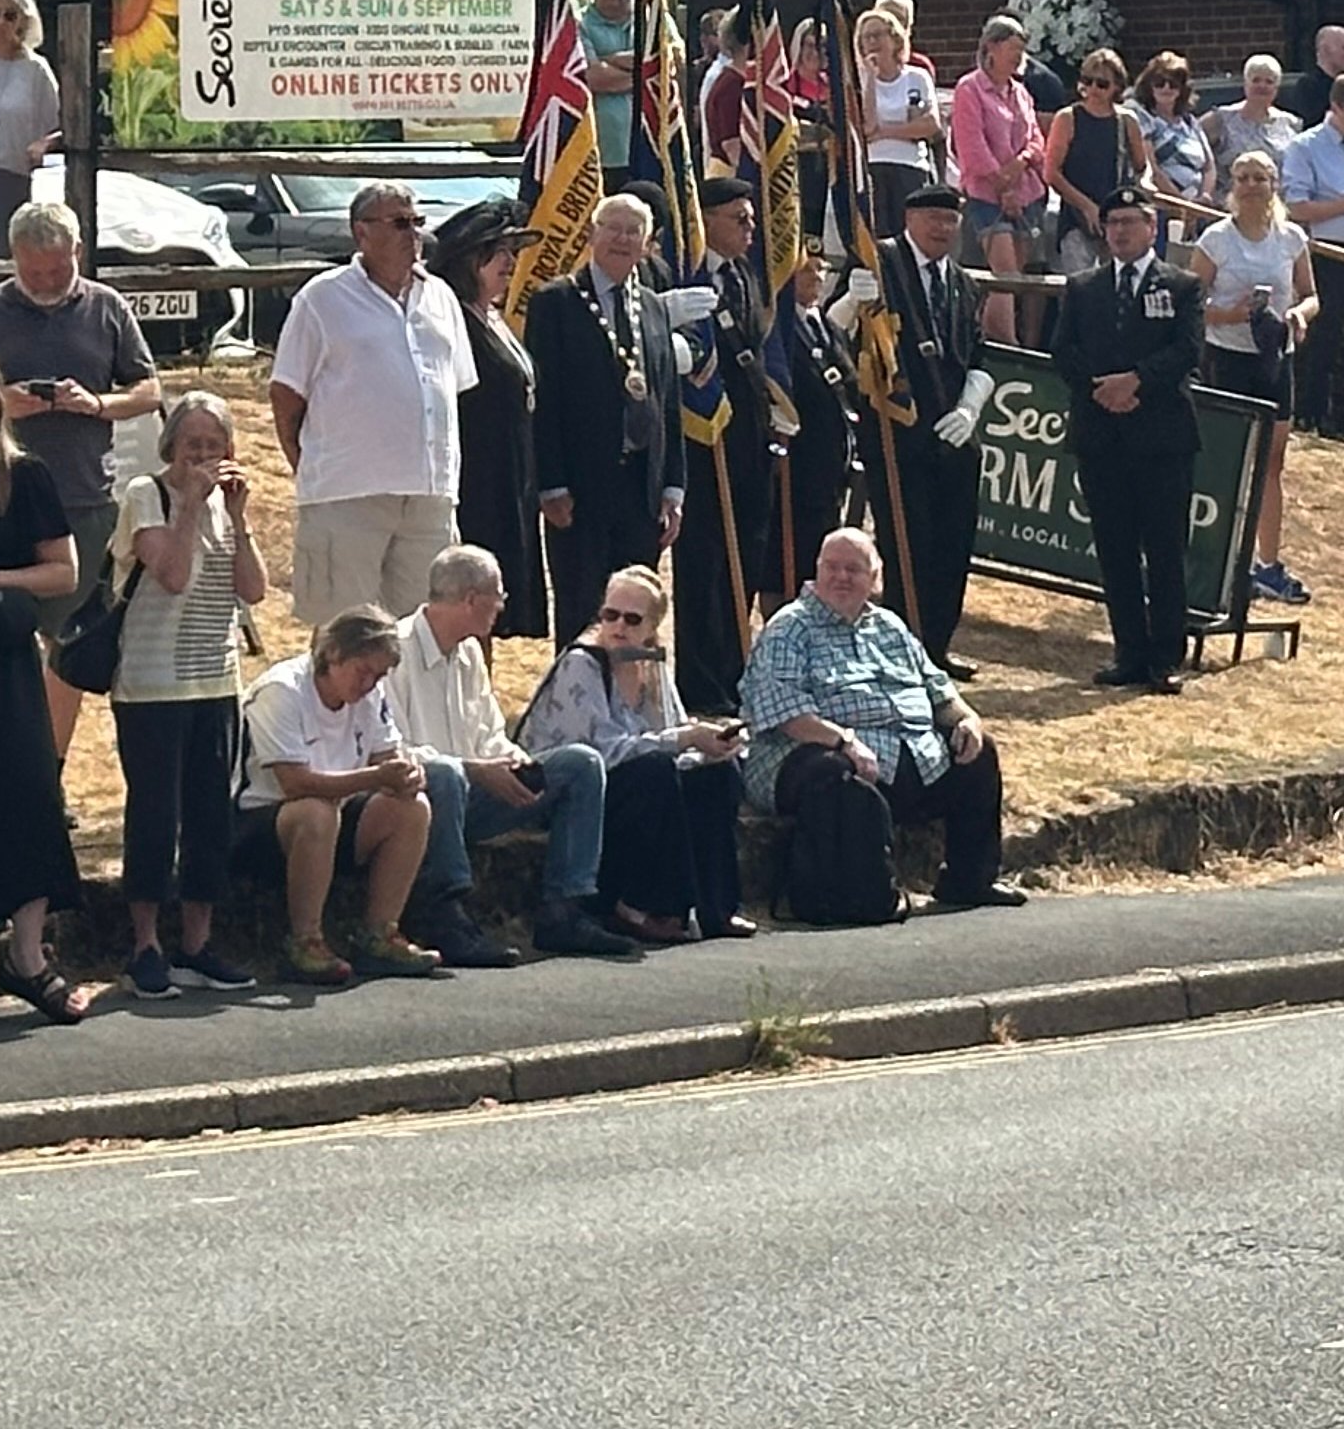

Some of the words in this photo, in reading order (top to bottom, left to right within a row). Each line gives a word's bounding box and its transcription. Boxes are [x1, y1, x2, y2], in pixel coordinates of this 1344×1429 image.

[321, 56, 342, 68] FOR
[271, 73, 360, 96] ONLINE
[367, 73, 462, 95] TICKETS
[469, 73, 529, 95] ONLY
[530, 224, 574, 283] ROYAL
[154, 293, 191, 316] ZGU
[985, 380, 1070, 446] Sec
[978, 442, 1058, 515] RM
[1010, 522, 1070, 552] LOCAL
[1085, 540, 1099, 559] A
